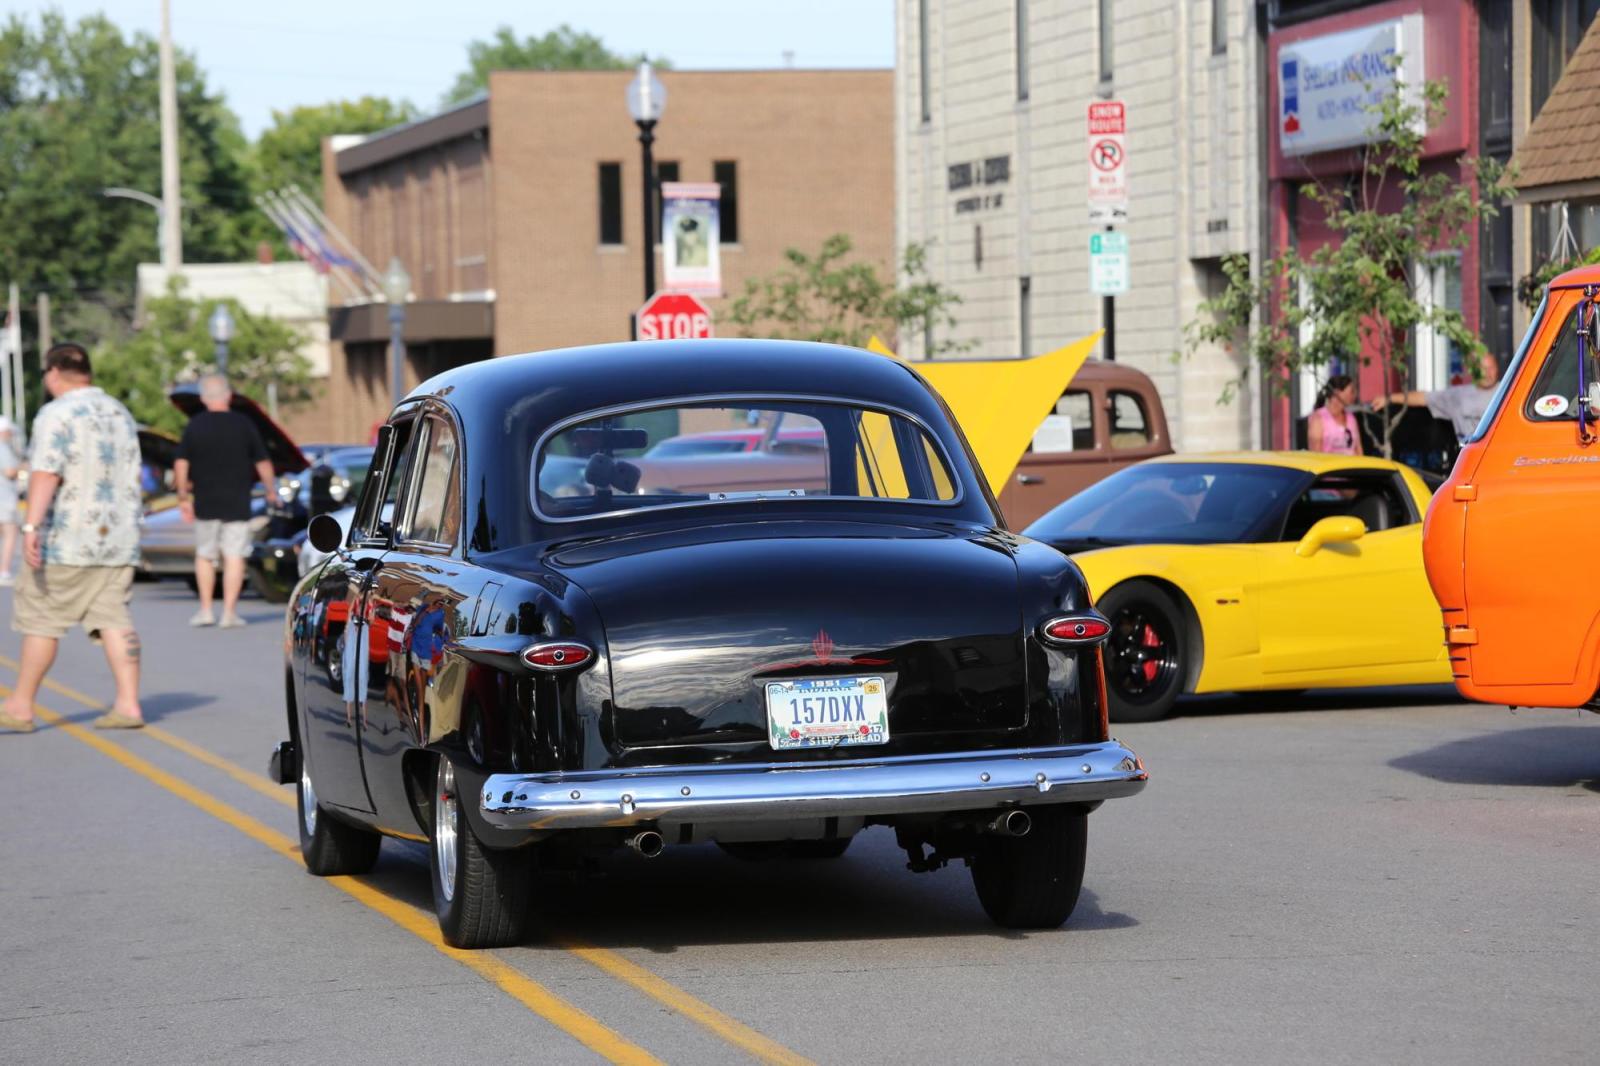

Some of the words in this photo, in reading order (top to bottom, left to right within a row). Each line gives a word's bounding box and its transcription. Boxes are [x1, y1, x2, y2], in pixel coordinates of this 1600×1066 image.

[641, 313, 708, 339] STOP
[799, 686, 852, 694] INDIANA
[810, 680, 840, 688] 1951
[790, 695, 865, 725] 157DXX
[809, 735, 841, 746] STEPS
[847, 733, 881, 744] AHEAD
